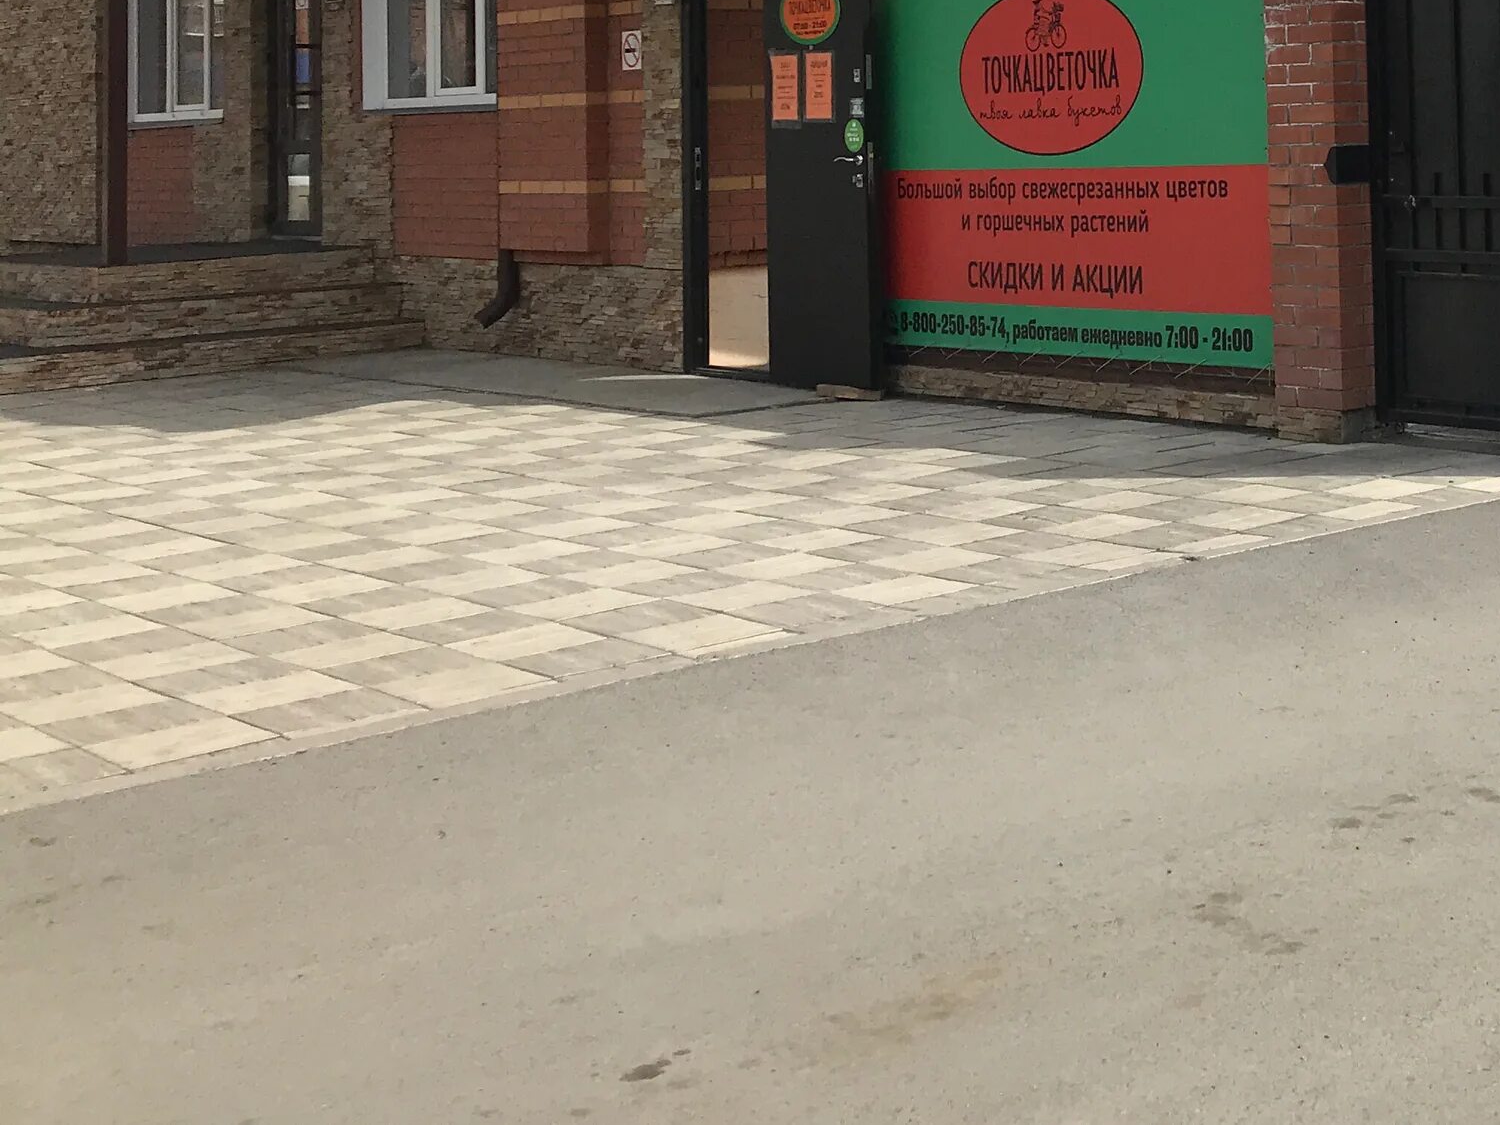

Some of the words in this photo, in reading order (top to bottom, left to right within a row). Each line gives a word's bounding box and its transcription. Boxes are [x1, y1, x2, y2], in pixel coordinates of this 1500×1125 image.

[982, 47, 1120, 96] ТОЧКАЦВЕТОЧКА
[980, 100, 1012, 119] твоя
[1018, 98, 1060, 119] лавка
[1067, 94, 1122, 127] букетов
[897, 177, 963, 200] Большой
[969, 176, 1016, 204] выбор
[1022, 178, 1160, 205] свежесрезанных
[1166, 178, 1229, 202] цветов
[961, 213, 971, 231] и
[976, 213, 1064, 236] горшечных
[1070, 209, 1150, 238] растений
[967, 260, 1044, 293] СКИДКИ
[1051, 263, 1065, 291] И
[1072, 263, 1144, 298] АКЦИИ
[900, 311, 1010, 343] 8-800-250-85-74,
[1012, 319, 1078, 345] работаем
[1081, 327, 1162, 350] ежедневно
[1165, 325, 1199, 350] 7:00
[1211, 327, 1254, 353] 21:00
